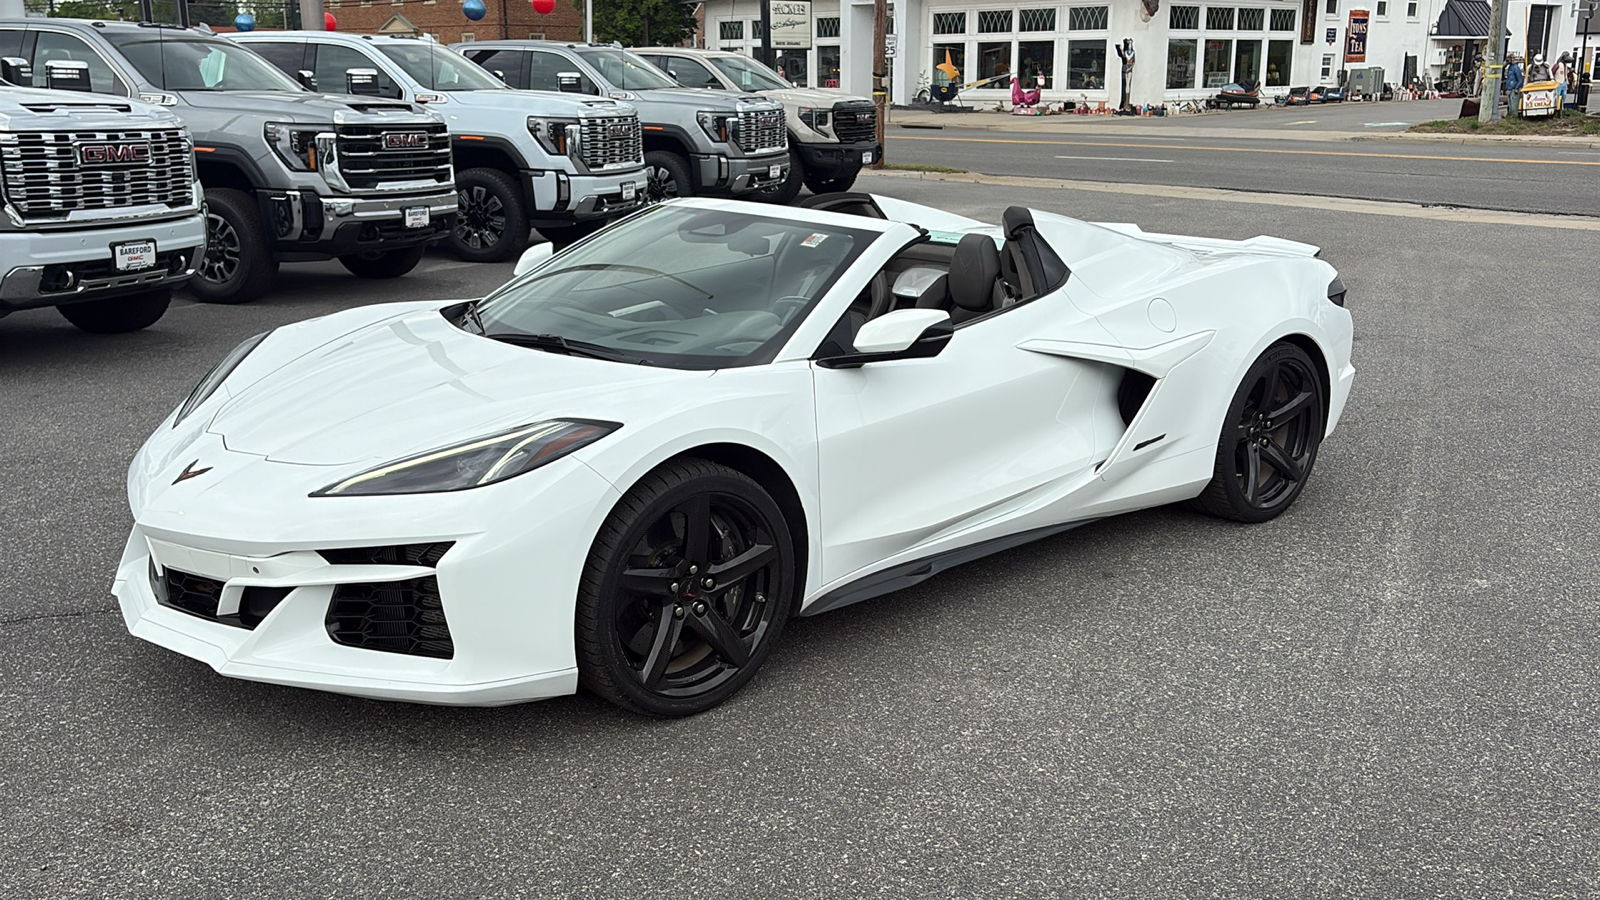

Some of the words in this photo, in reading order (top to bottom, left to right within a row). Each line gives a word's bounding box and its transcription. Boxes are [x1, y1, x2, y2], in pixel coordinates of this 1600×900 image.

[885, 46, 896, 55] 25
[1350, 40, 1363, 53] TEA
[386, 134, 428, 147] GMC
[82, 144, 150, 163] GMC
[120, 246, 152, 256] BAREFORD
